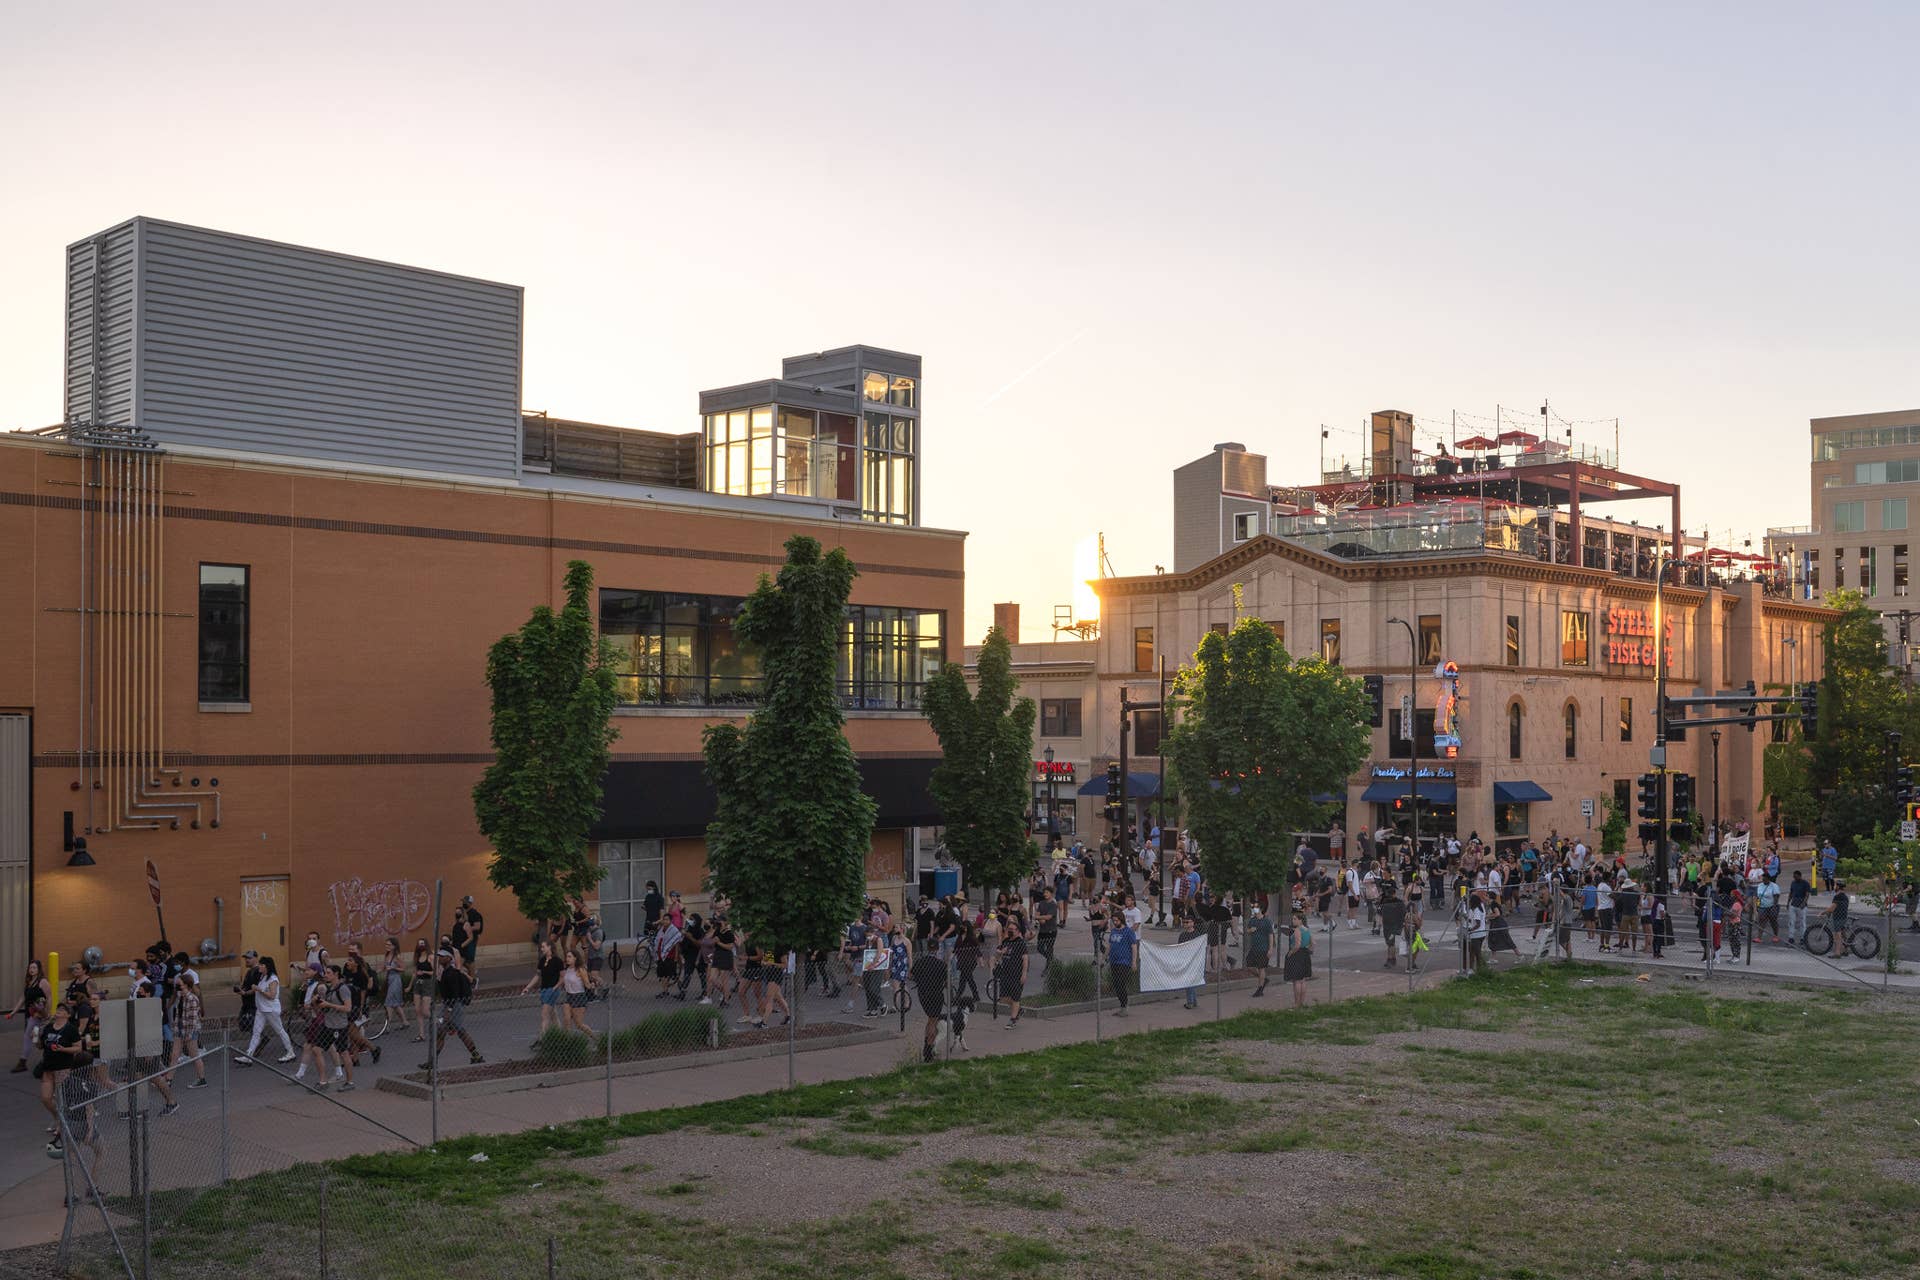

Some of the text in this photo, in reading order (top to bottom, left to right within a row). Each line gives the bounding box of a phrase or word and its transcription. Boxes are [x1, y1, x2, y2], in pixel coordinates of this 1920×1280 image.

[1607, 607, 1674, 639] STELL'S
[1608, 641, 1674, 668] FISH CAE
[1437, 766, 1454, 777] Bar
